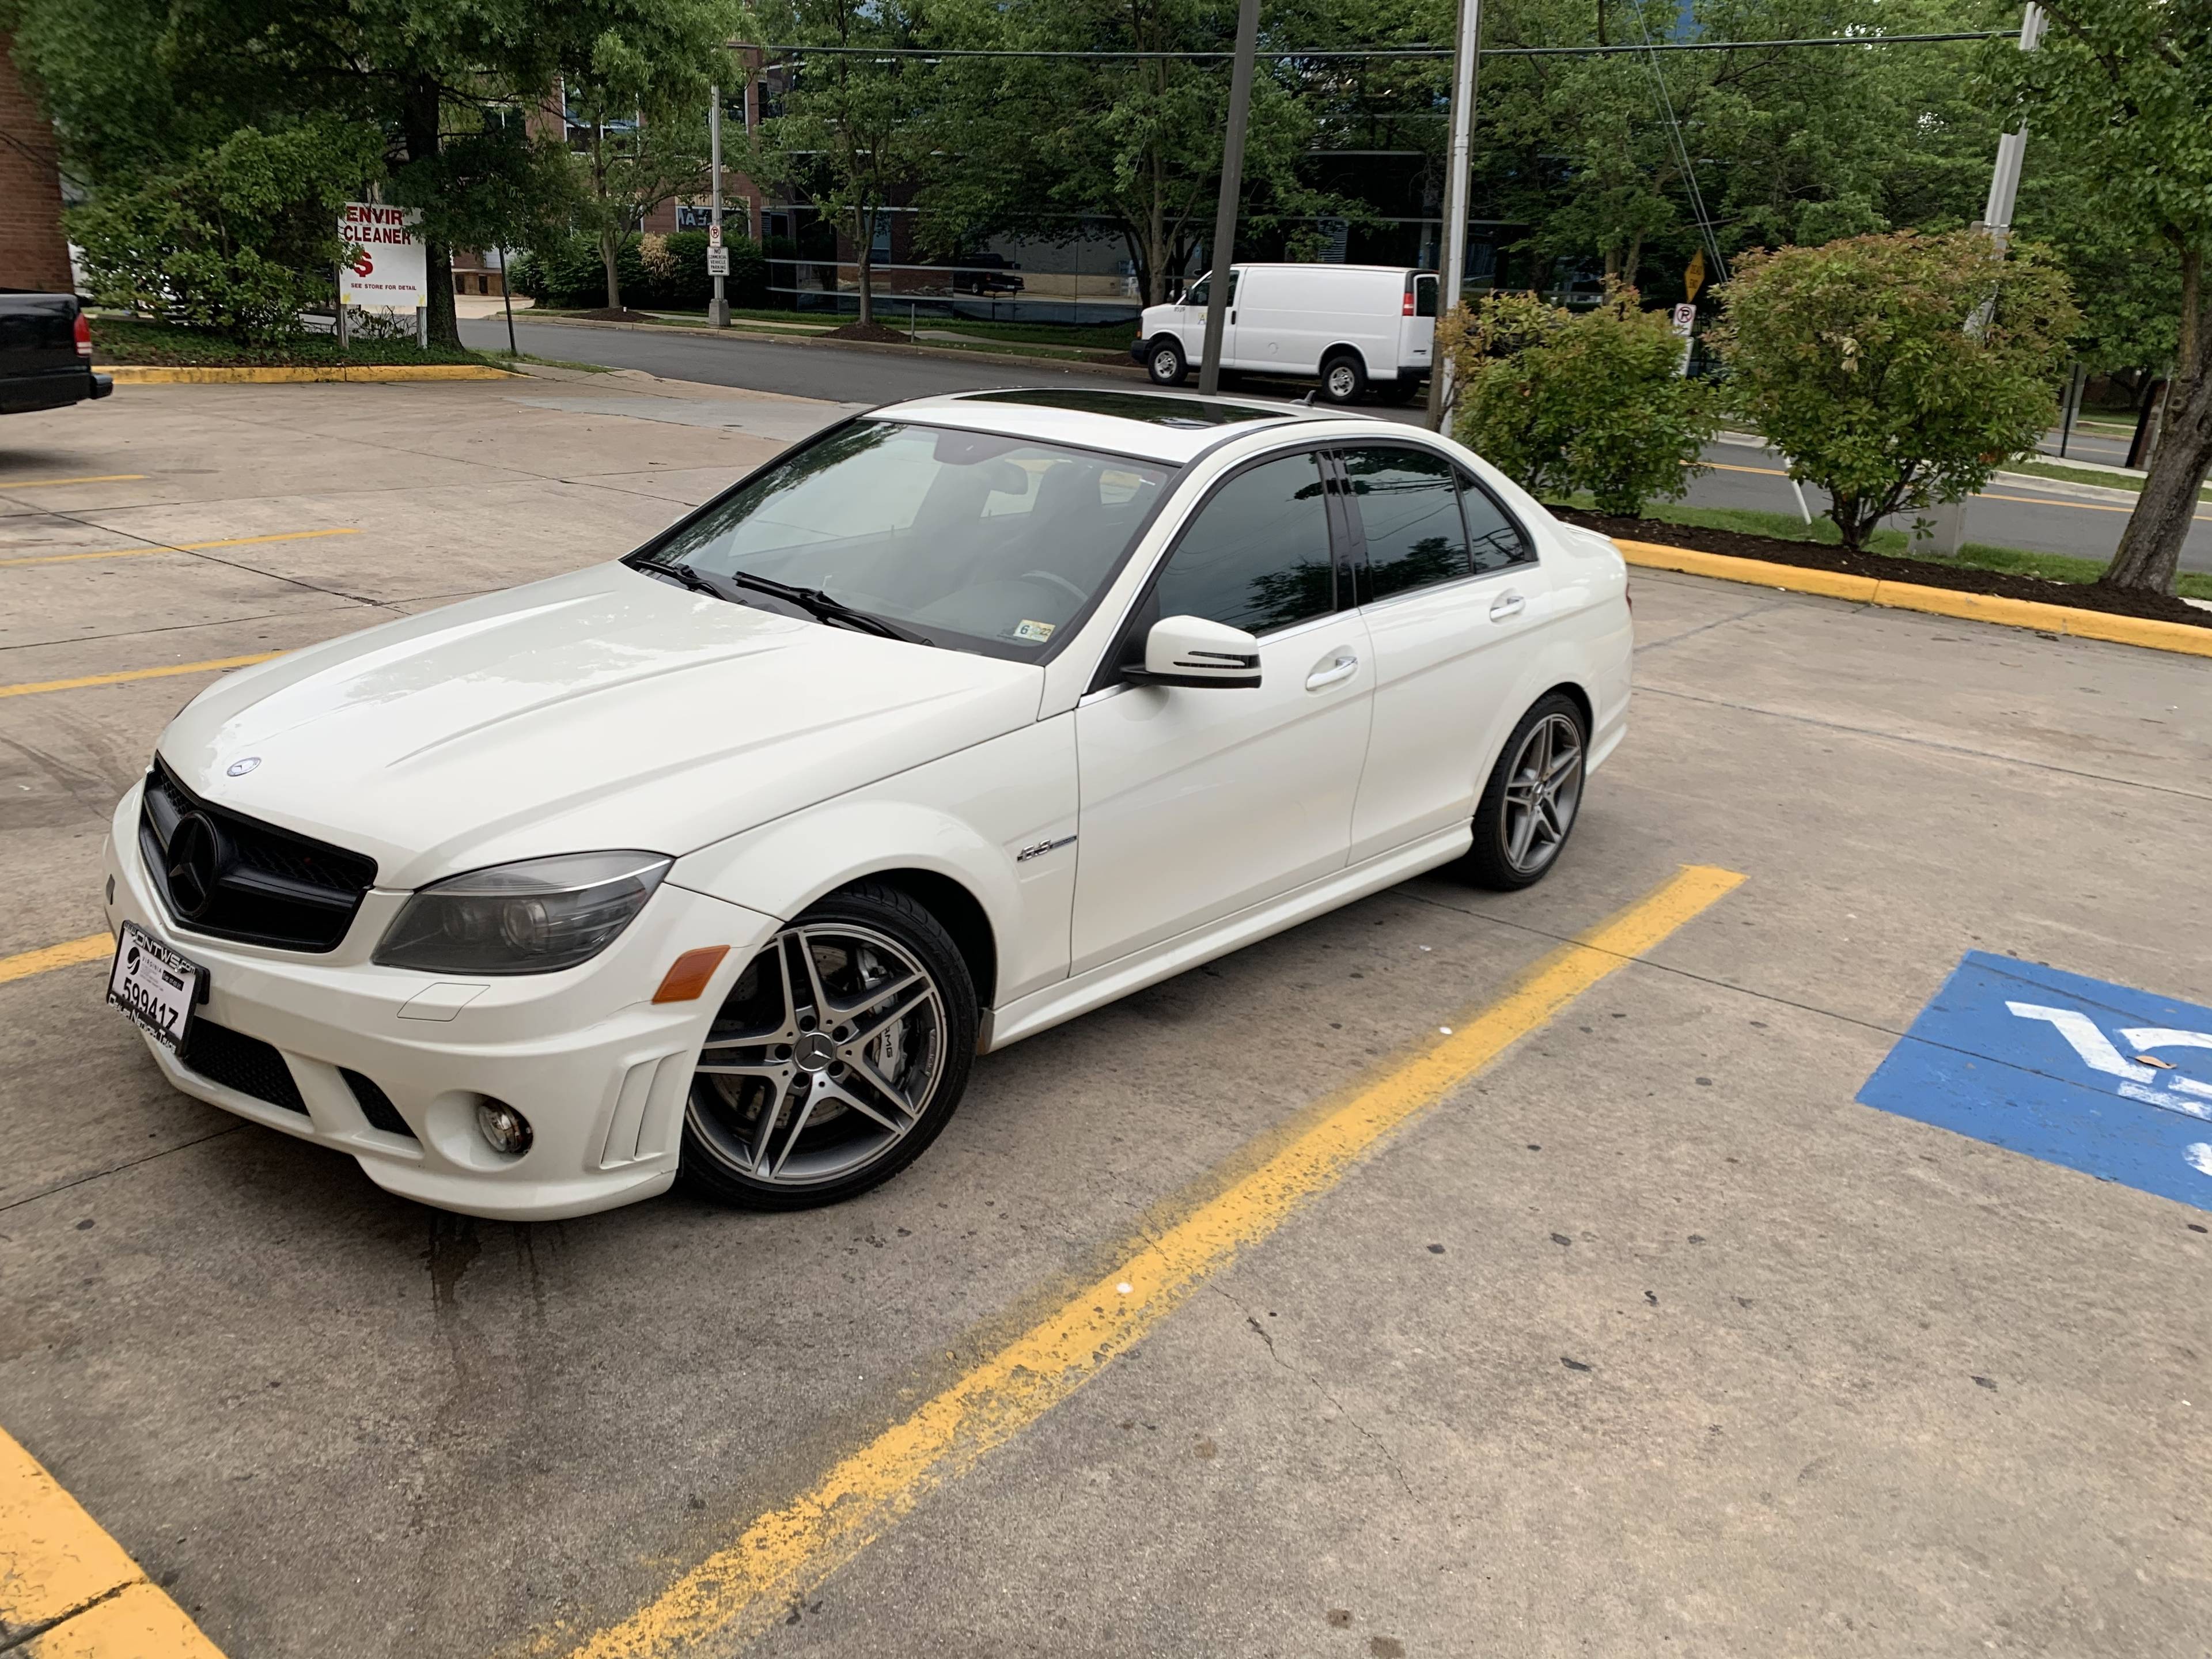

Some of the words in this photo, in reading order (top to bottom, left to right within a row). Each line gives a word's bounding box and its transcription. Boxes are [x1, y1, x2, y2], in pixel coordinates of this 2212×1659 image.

[346, 206, 403, 226] ENVIR
[344, 225, 411, 245] CLEANER
[1020, 625, 1030, 635] 6
[1040, 628, 1051, 636] 22
[142, 957, 162, 973] VIRGINIA
[124, 977, 179, 1031] 599417
[884, 1026, 893, 1058] AMG
